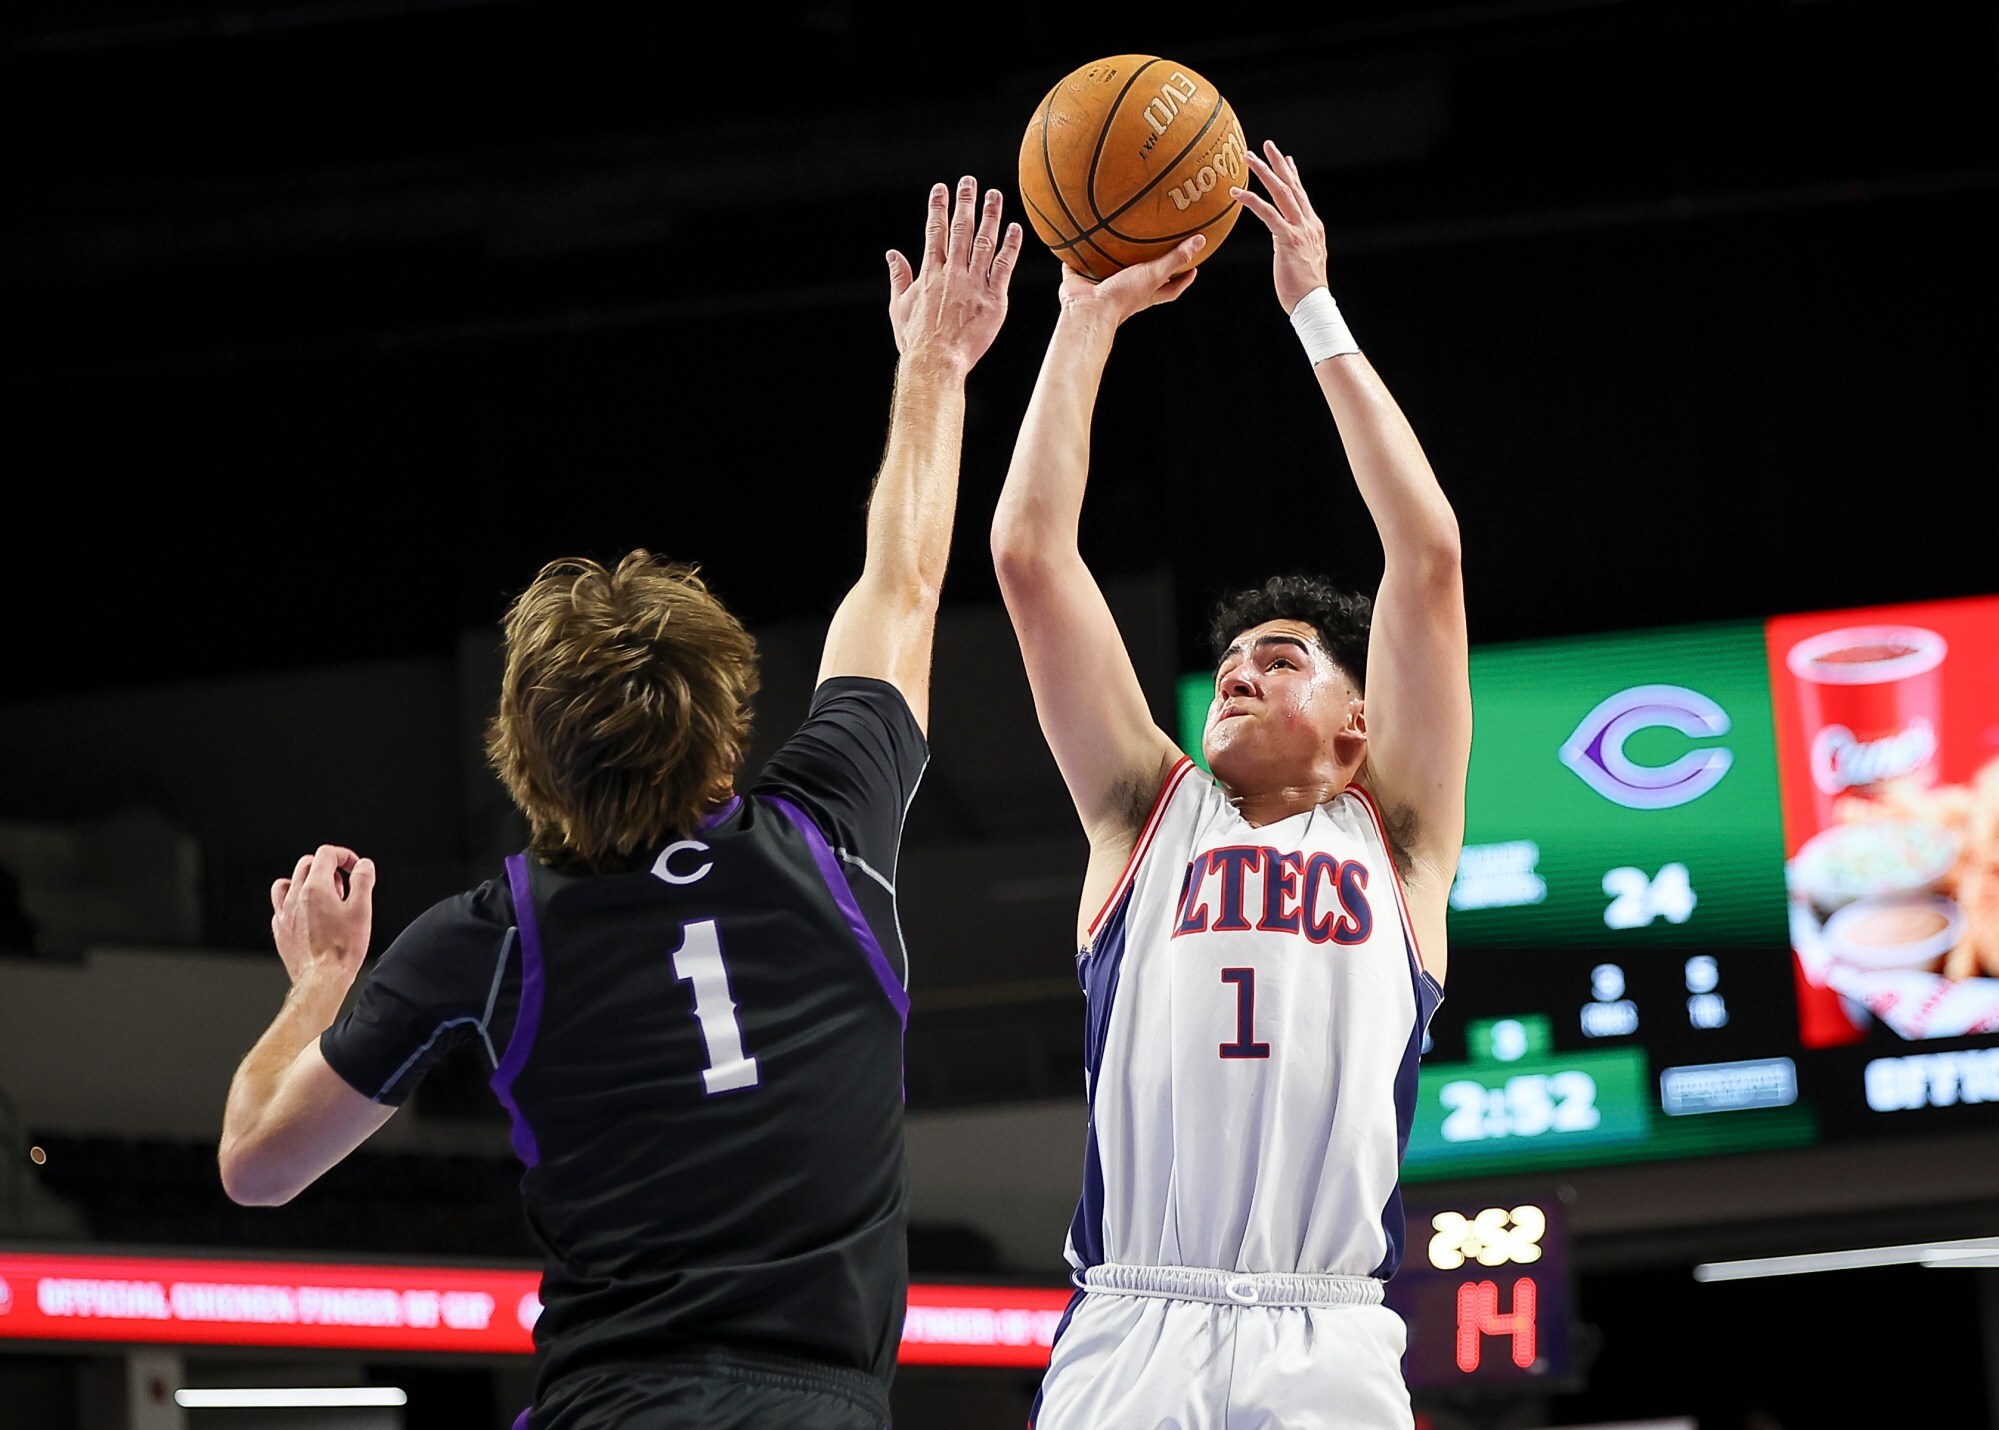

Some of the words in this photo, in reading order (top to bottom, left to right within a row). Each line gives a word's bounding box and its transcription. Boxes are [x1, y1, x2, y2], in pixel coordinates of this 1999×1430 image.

[1143, 70, 1198, 136] EVO
[1139, 133, 1159, 161] NXT
[1558, 683, 1735, 811] C
[651, 839, 714, 885] C
[1171, 845, 1373, 945] ZTECS
[1602, 862, 1698, 930] 24
[668, 917, 762, 1098] 1
[1219, 967, 1270, 1059] 1
[1439, 1070, 1601, 1142] 2:52
[1428, 1205, 1546, 1270] 2:52
[1456, 1277, 1537, 1373] 14
